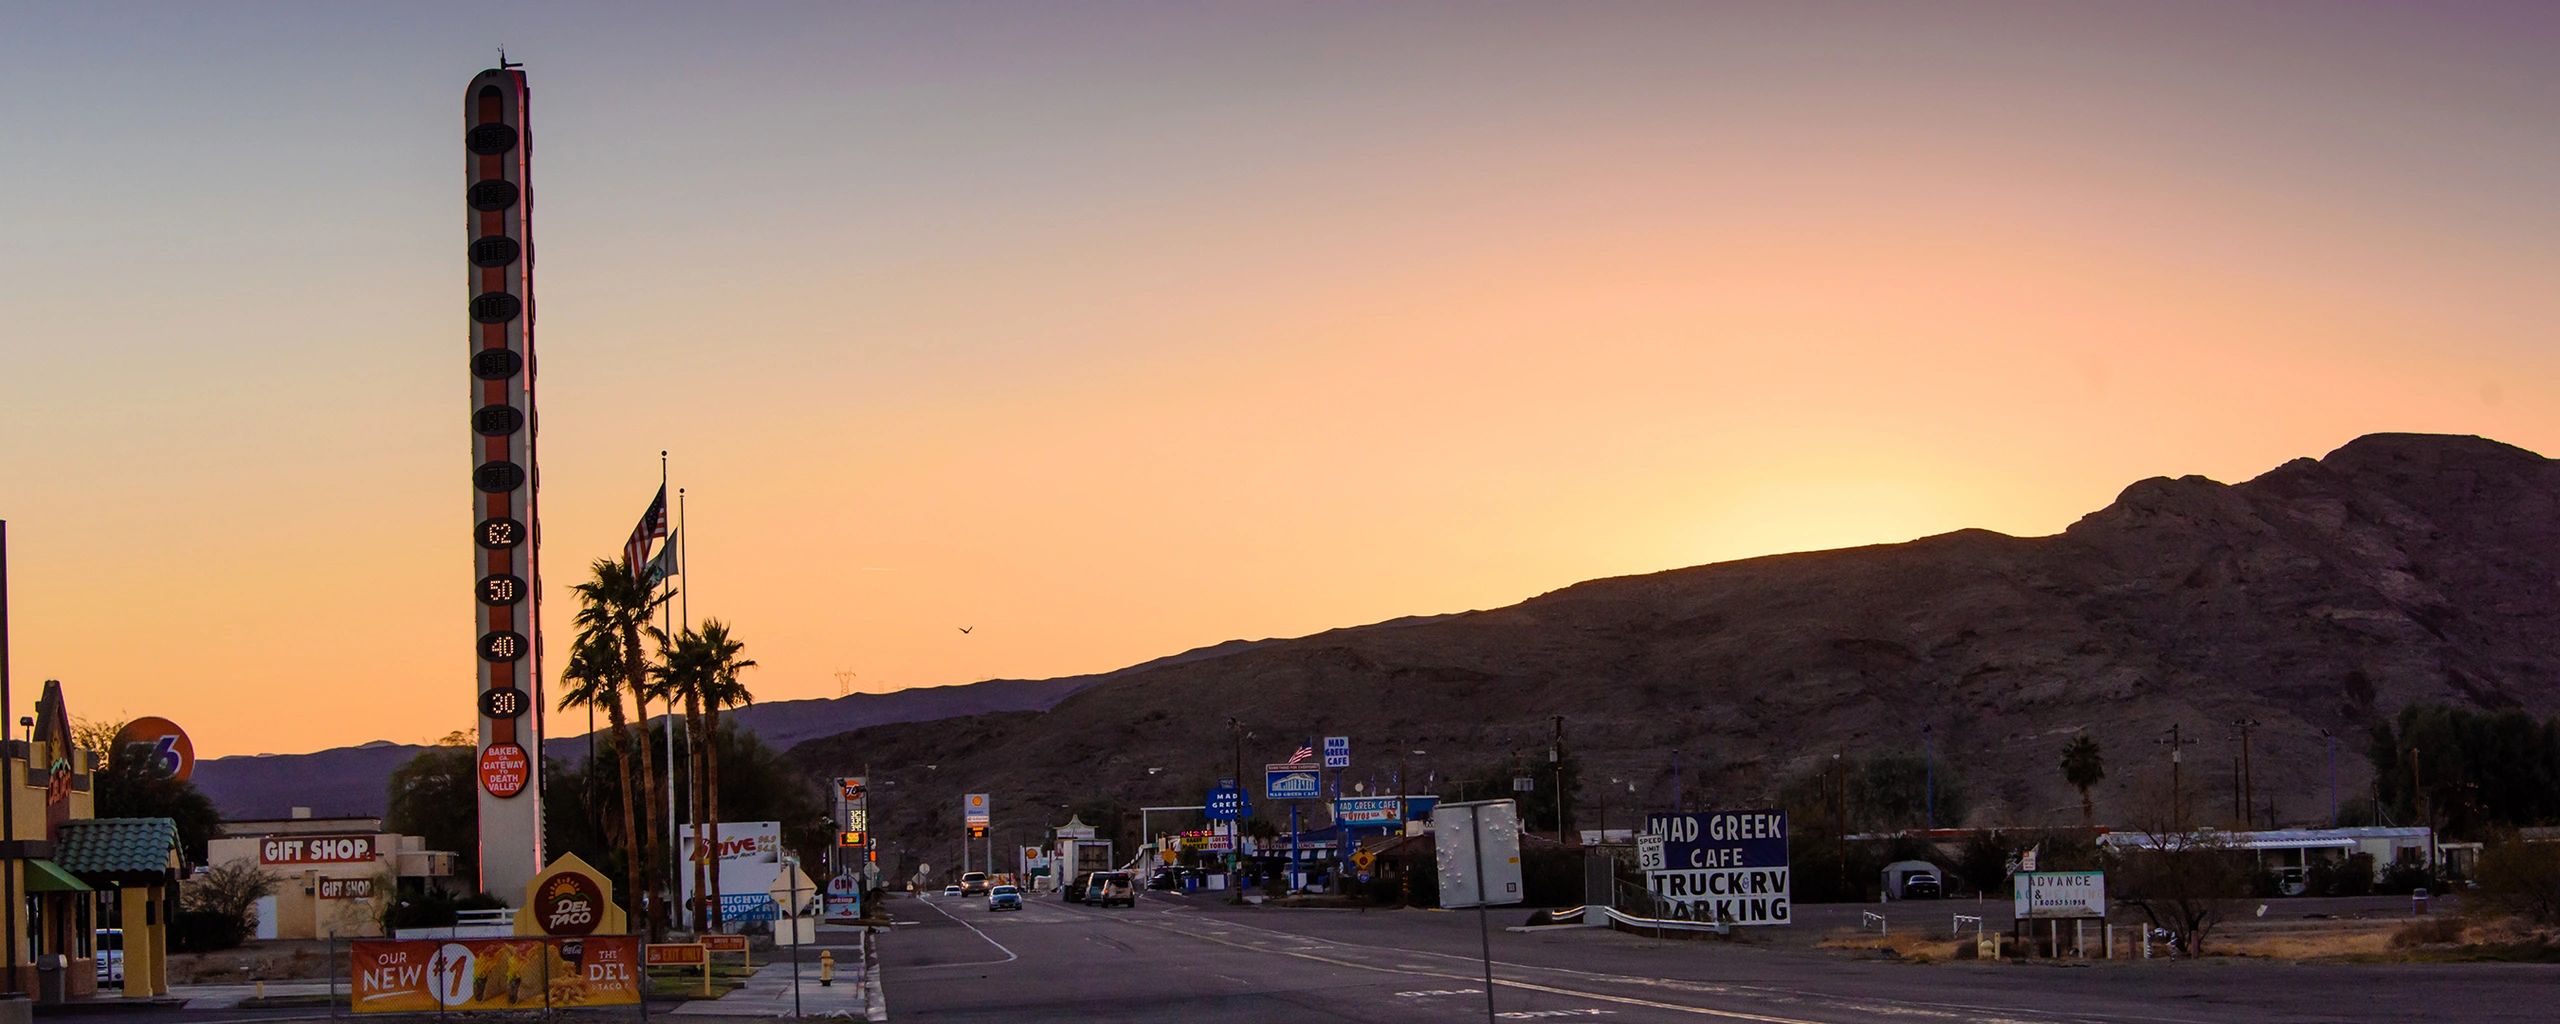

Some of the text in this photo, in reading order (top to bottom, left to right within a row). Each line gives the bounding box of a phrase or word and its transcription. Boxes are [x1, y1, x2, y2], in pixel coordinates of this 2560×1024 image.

[489, 524, 511, 544] 62
[490, 580, 513, 600] 50
[492, 637, 514, 657] 40
[493, 692, 515, 714] 30
[1328, 738, 1345, 747] MAD
[488, 747, 518, 756] BAKER
[1325, 748, 1349, 756] GREEK
[483, 761, 524, 769] GATEWAY
[1327, 757, 1347, 765] CAFE
[490, 774, 518, 782] DEATH
[488, 783, 520, 791] VALLEY
[1354, 802, 1376, 810] GREEK
[1379, 800, 1396, 809] CAFE
[1652, 814, 1782, 843] MAD GREEK
[1639, 837, 1662, 845] SPEED
[265, 839, 368, 861] GIFT SHOP
[1642, 853, 1660, 867] 35
[1690, 848, 1744, 868] CAFE
[1651, 871, 1786, 896] TRUCK & RV
[2030, 876, 2091, 886] ADVANCE
[322, 880, 371, 897] GIFT SHOP
[2035, 889, 2042, 900] &
[720, 895, 770, 904] HIGHWA
[556, 900, 592, 914] DEL
[550, 912, 592, 929] TACO
[378, 952, 407, 966] OUR
[598, 950, 618, 959] THE
[662, 948, 679, 961] EXIT
[682, 947, 702, 961] ONLY
[363, 964, 422, 992] NEW
[432, 954, 468, 997] #1
[589, 963, 630, 981] DEL
[598, 983, 622, 992] TACO
